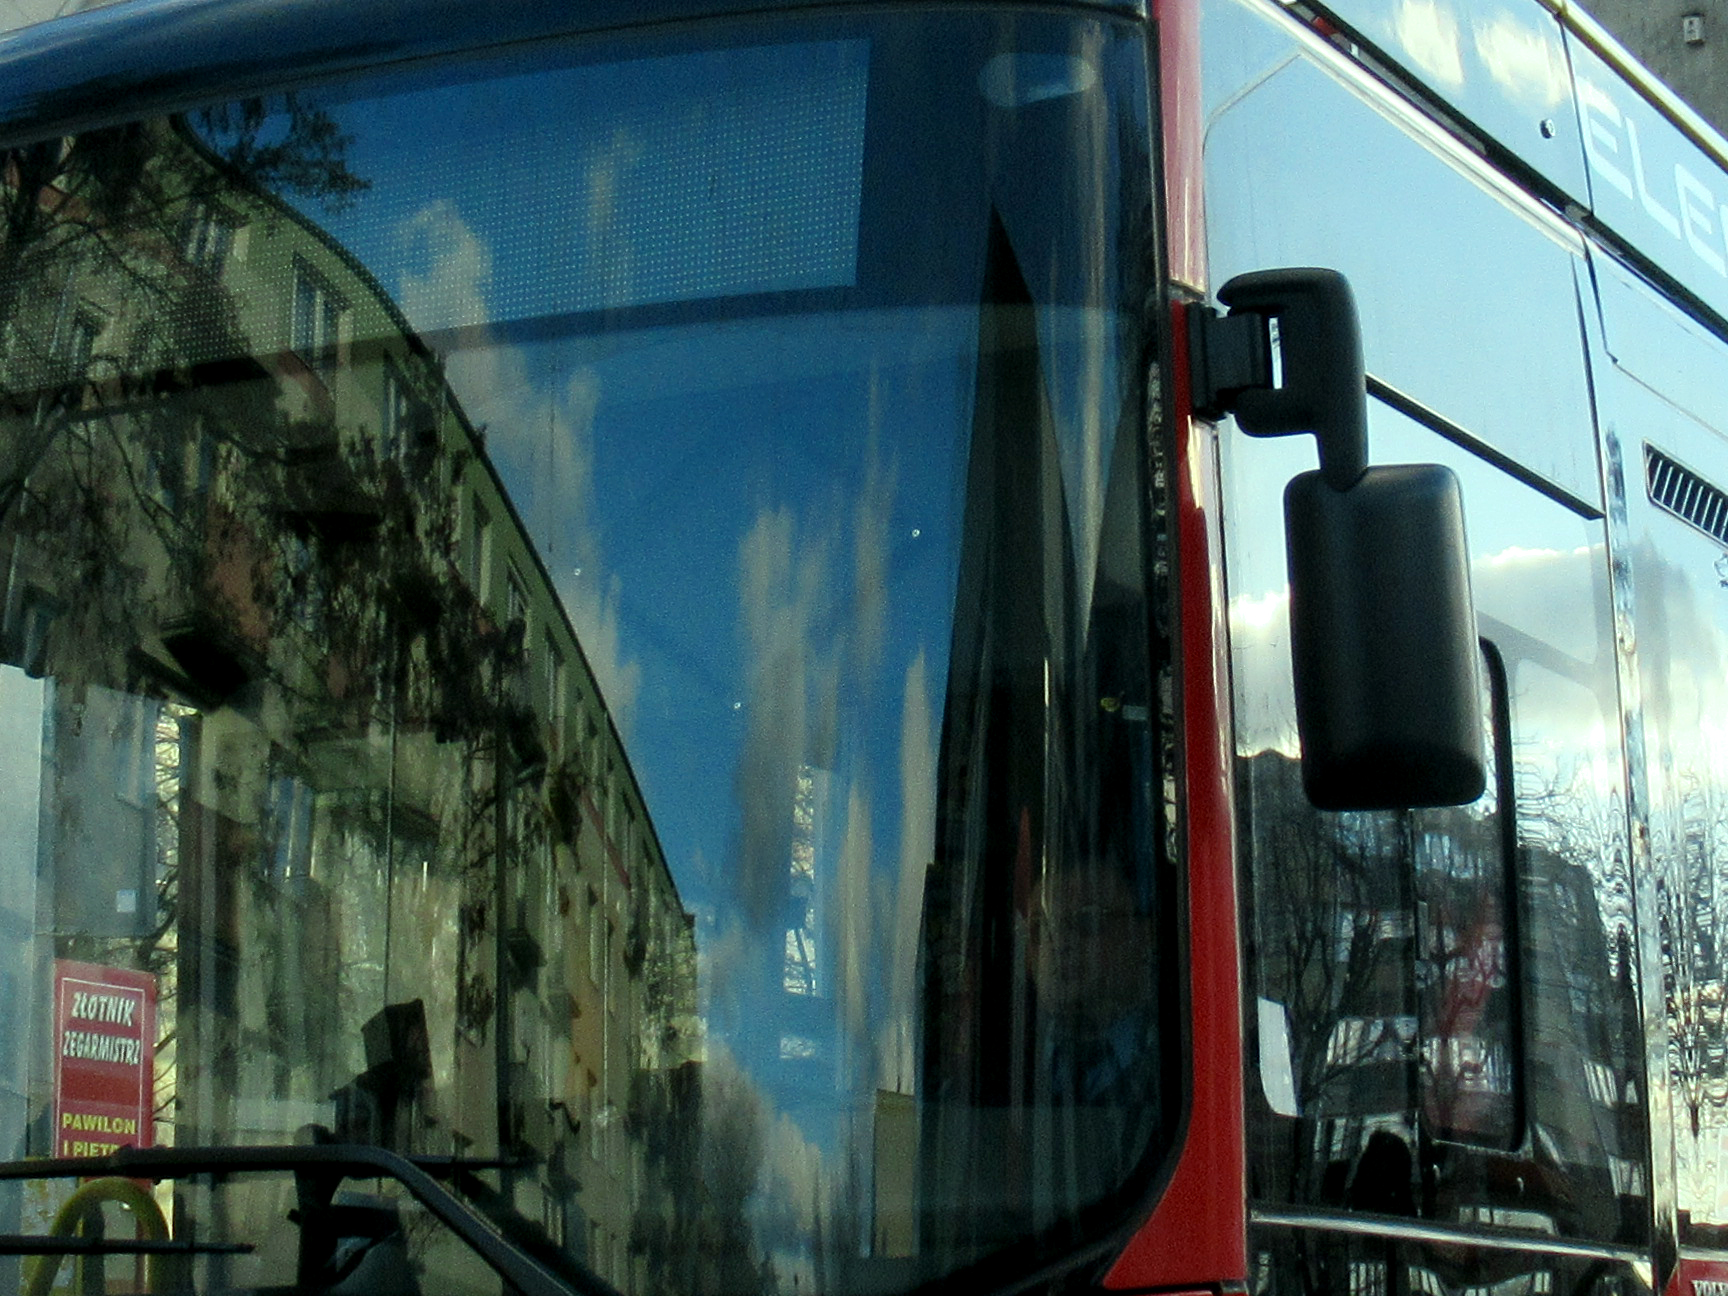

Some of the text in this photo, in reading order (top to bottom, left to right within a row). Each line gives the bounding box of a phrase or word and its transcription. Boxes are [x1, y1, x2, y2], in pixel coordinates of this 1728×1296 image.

[72, 990, 136, 1027] ZŁOTNIK
[62, 1030, 141, 1065] ZEGARMISTRZ
[62, 1112, 137, 1135] PAWILON
